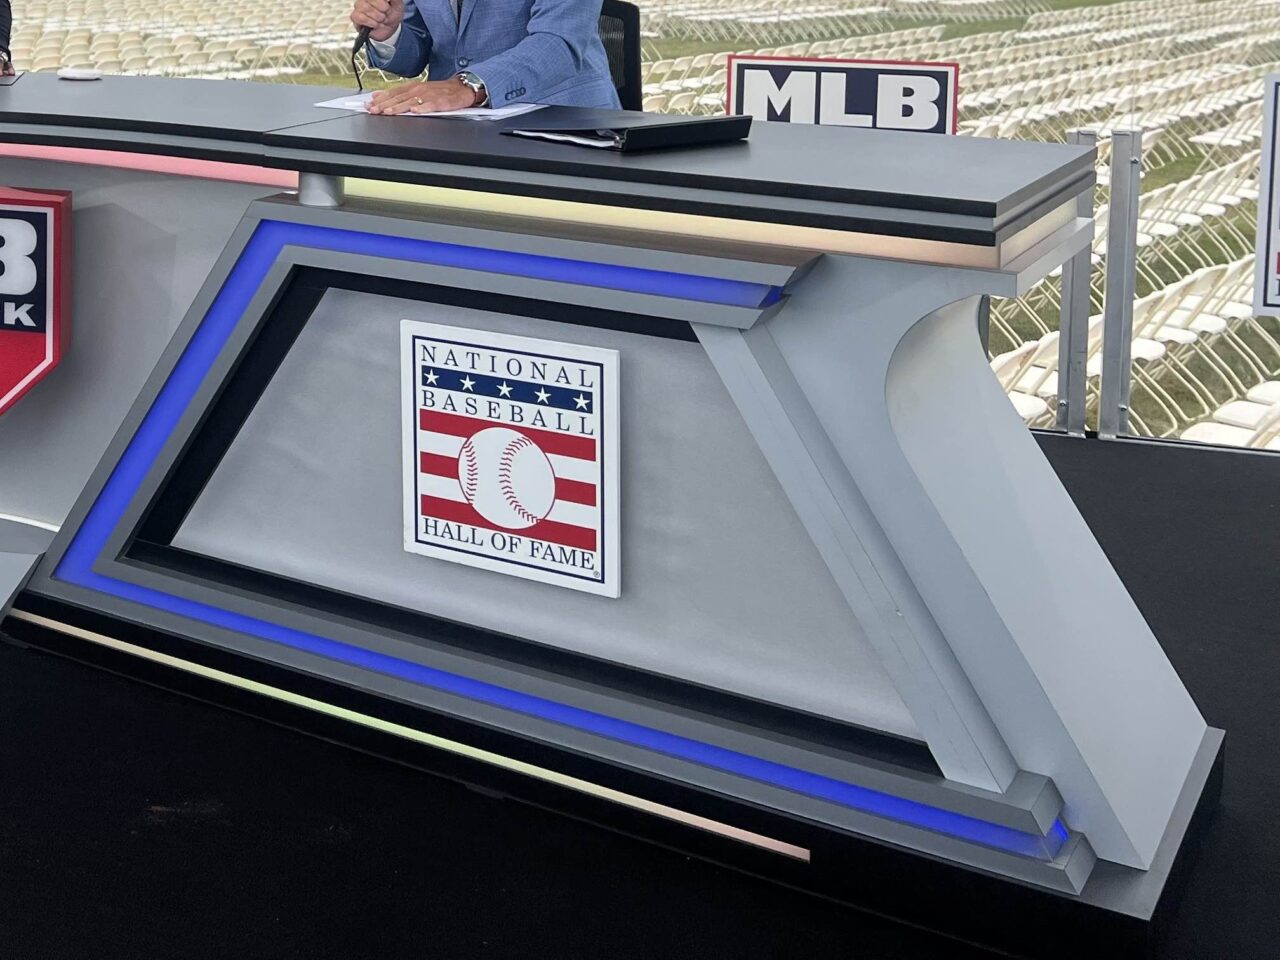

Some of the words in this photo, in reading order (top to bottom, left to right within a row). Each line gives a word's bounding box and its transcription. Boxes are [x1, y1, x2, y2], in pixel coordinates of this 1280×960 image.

[743, 69, 941, 131] MLB
[420, 344, 594, 388] NATIONAL
[421, 389, 594, 436] BASEBALL
[423, 516, 484, 547] HALL
[490, 532, 522, 554] OF
[529, 541, 595, 571] FAME
